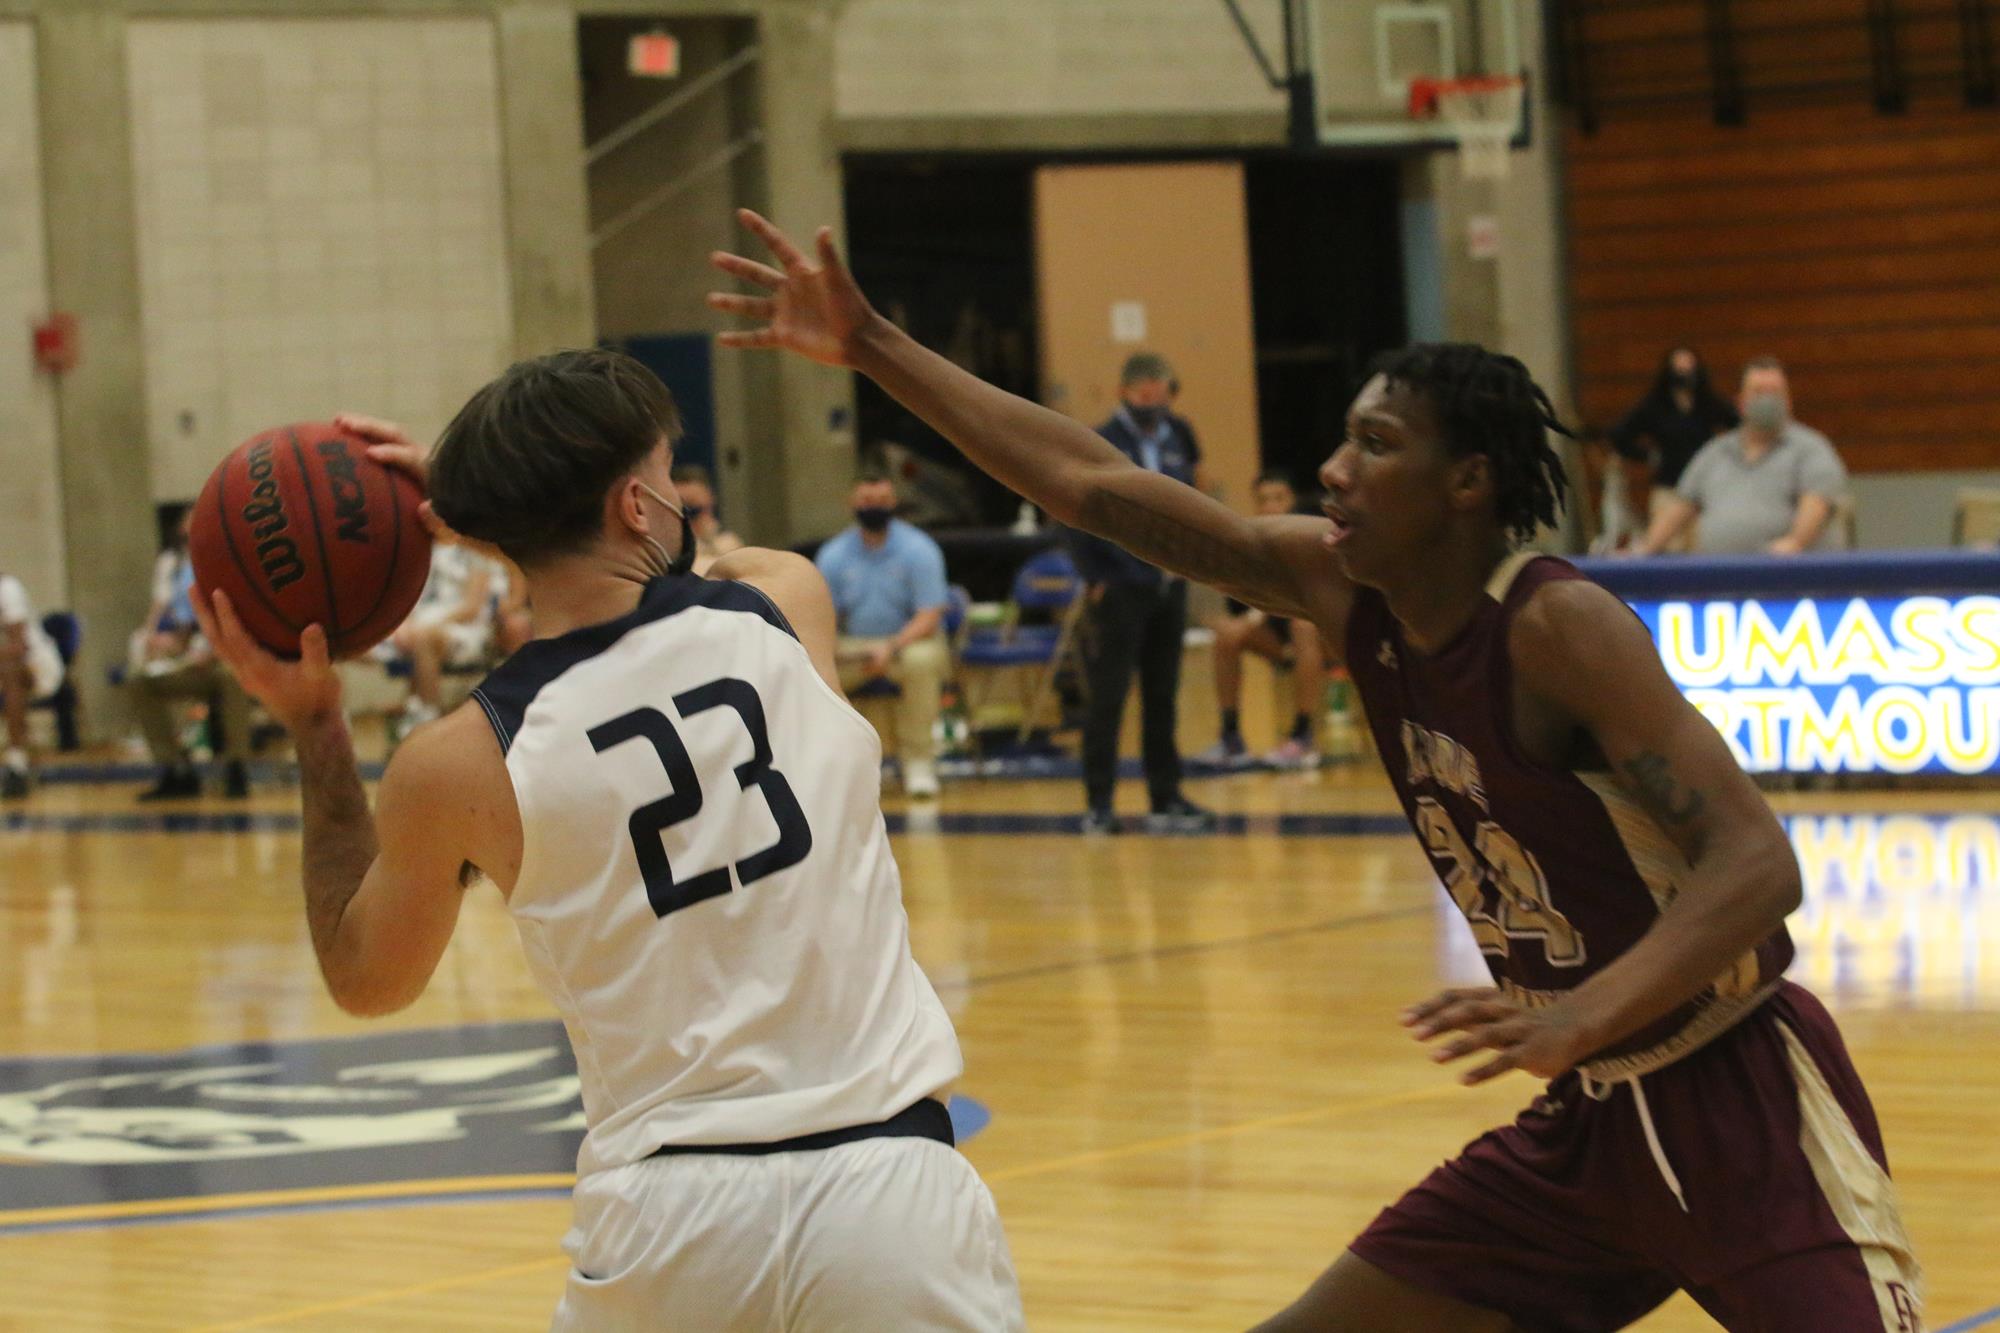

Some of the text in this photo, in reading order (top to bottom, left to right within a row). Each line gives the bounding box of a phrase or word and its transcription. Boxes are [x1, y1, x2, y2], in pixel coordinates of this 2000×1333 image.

[242, 439, 305, 593] Wilson
[1659, 596, 2000, 686] UMASS
[586, 677, 812, 920] 23
